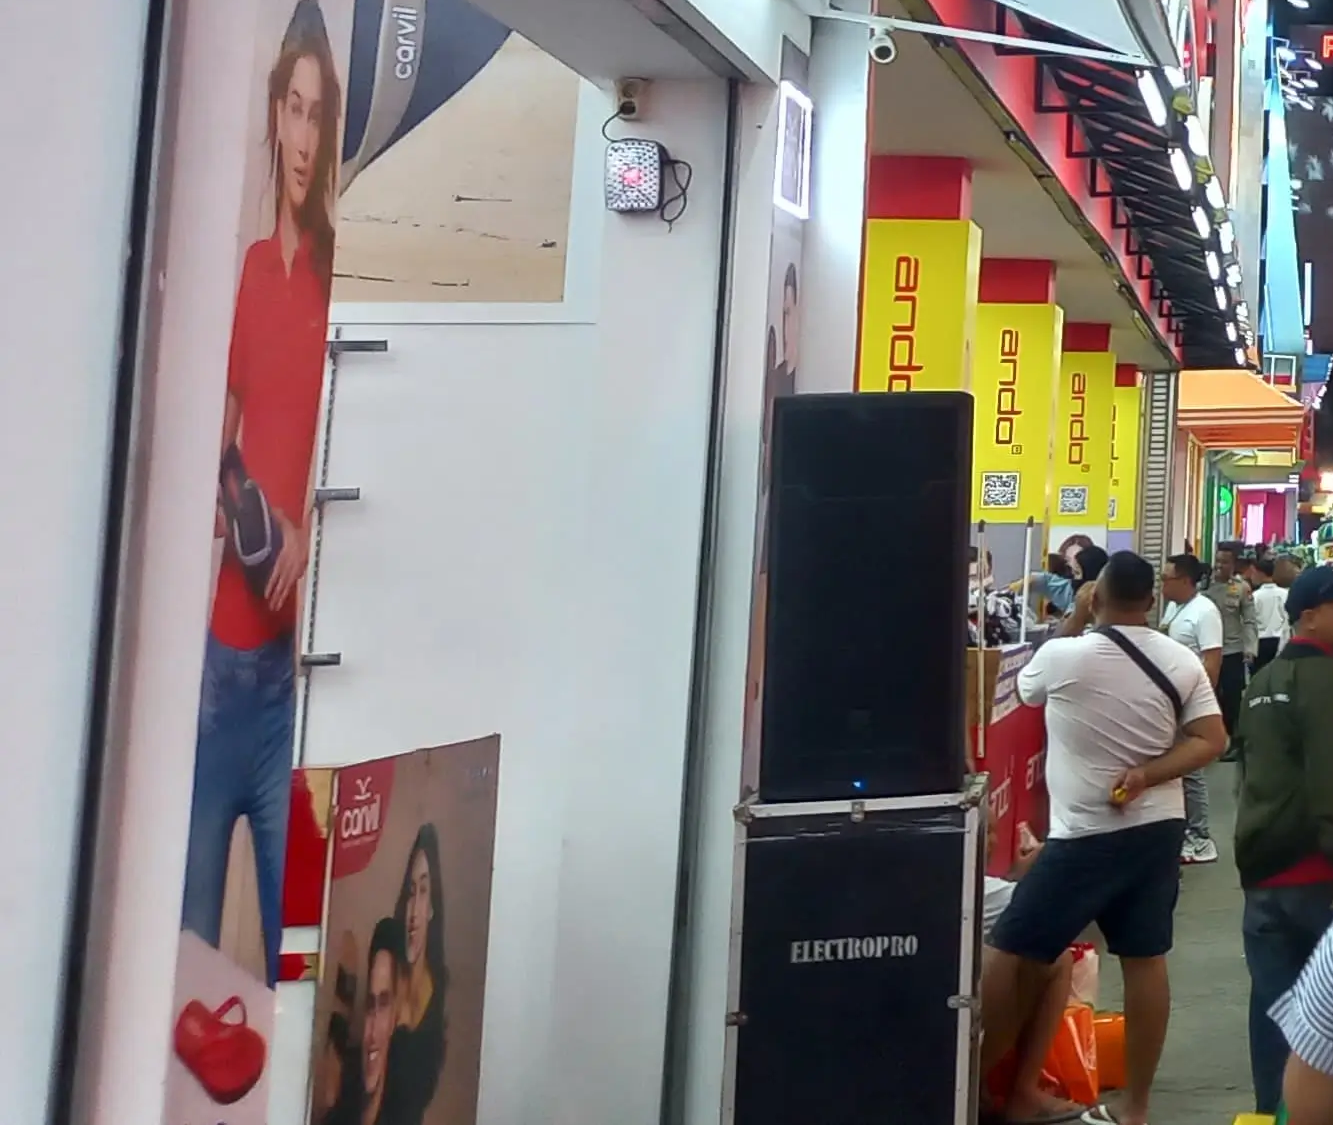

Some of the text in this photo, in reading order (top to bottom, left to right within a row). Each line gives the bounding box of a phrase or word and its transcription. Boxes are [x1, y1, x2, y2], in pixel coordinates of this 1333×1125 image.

[391, 6, 418, 79] carvil
[995, 328, 1023, 446] ando
[1068, 372, 1090, 466] ando
[790, 935, 919, 964] ELECTROPRO
